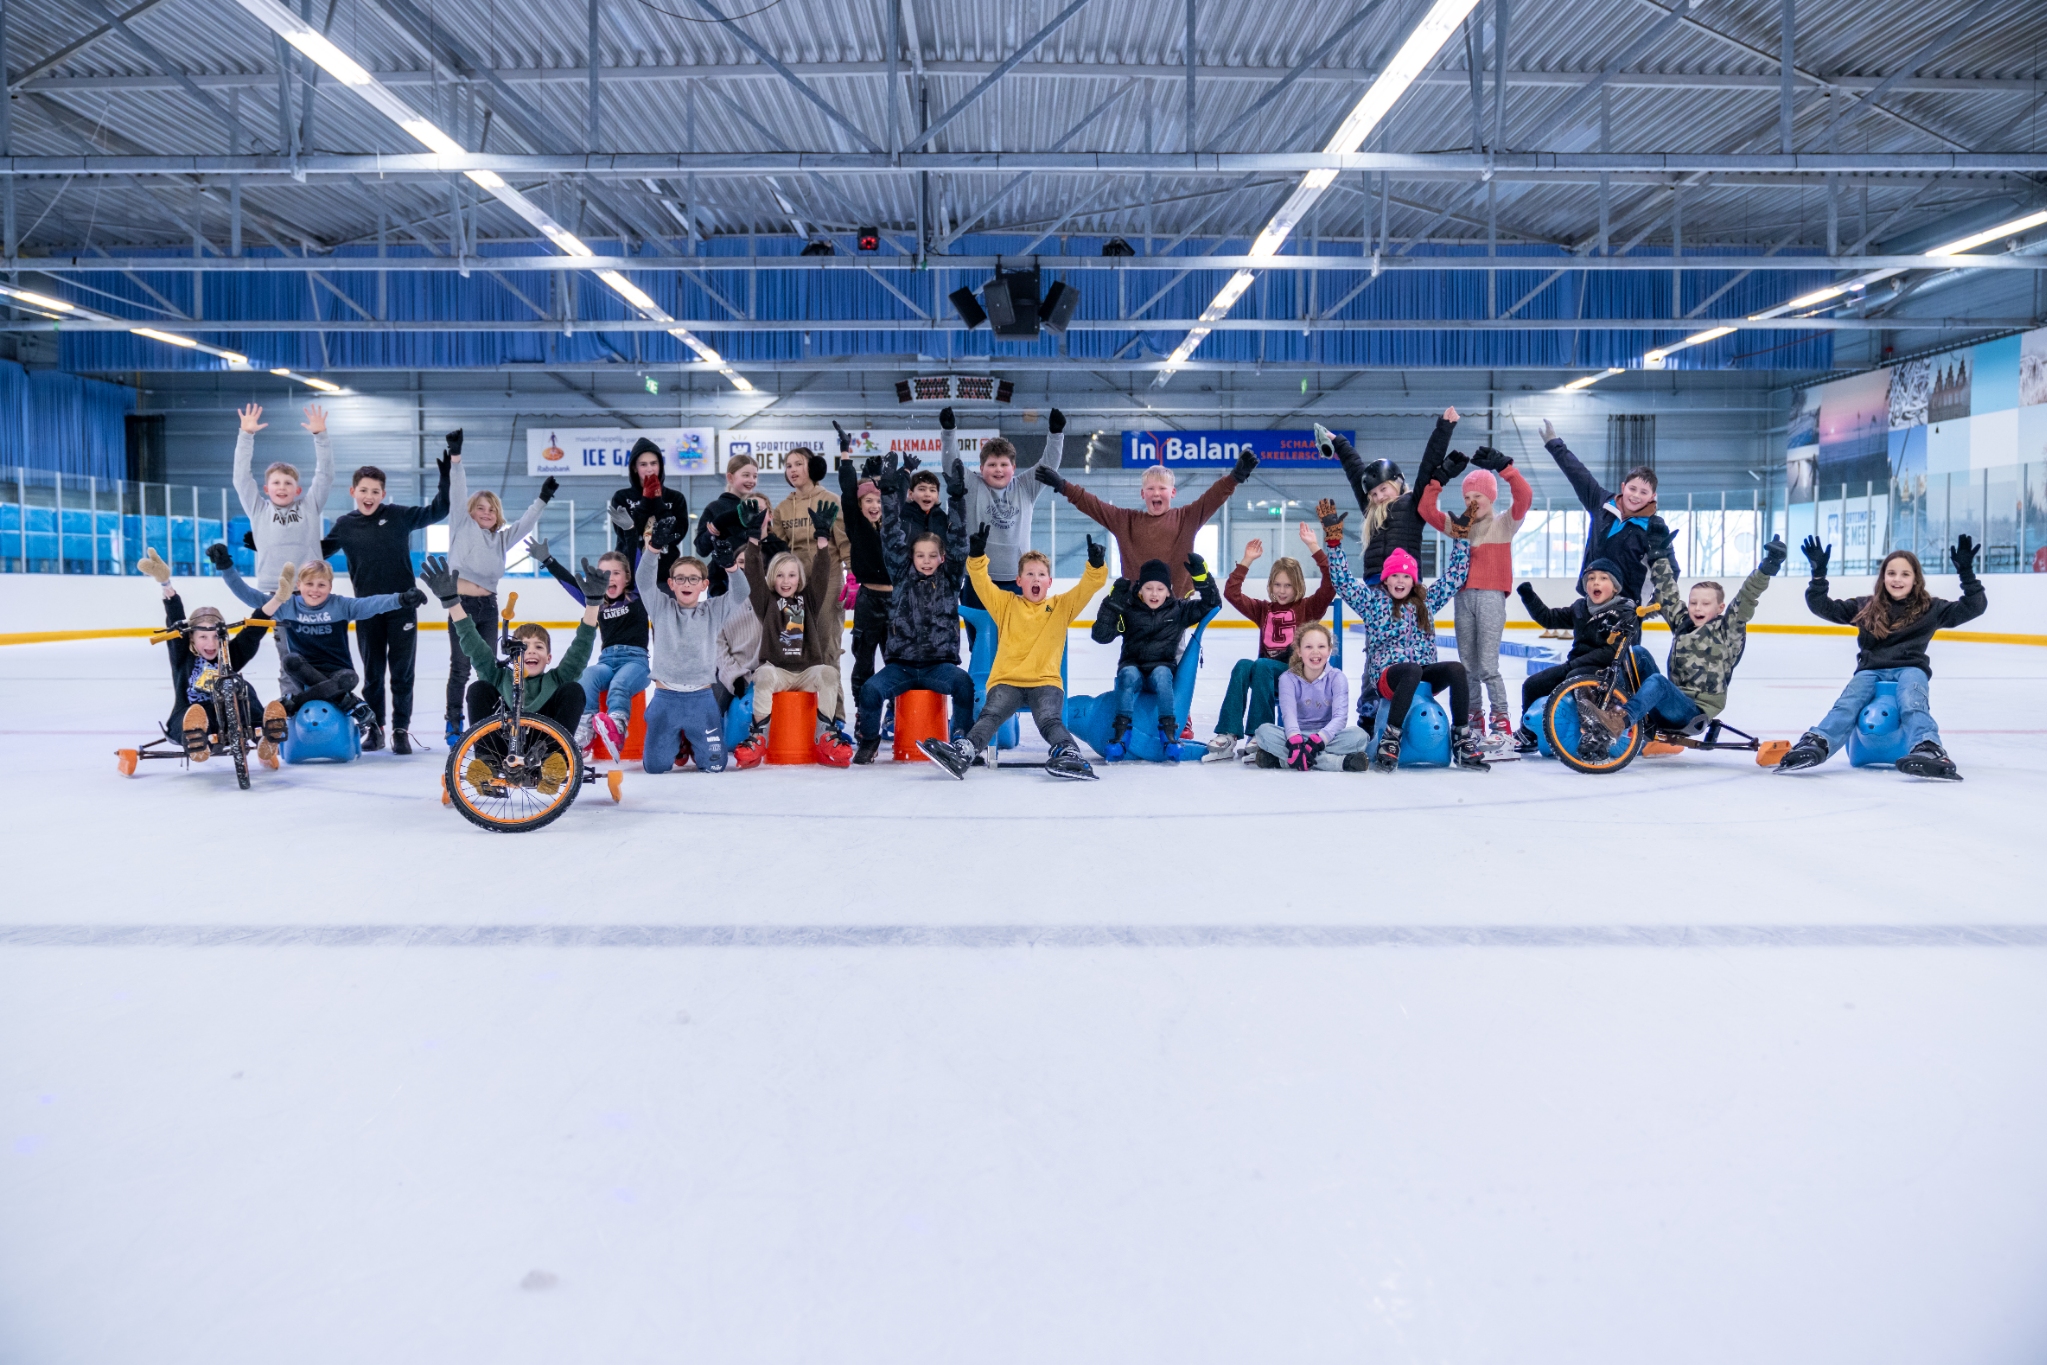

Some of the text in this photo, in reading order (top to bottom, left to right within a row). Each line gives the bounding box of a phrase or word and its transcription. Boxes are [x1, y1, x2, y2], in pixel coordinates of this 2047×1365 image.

[890, 438, 942, 452] ALKMAAR
[1281, 440, 1317, 449] SCHAA
[583, 449, 606, 466] ICE
[537, 465, 571, 473] Rabobank
[1851, 524, 1876, 546] MEET
[603, 605, 630, 620] LAKERS
[295, 624, 333, 636] JONES
[1263, 609, 1297, 651] G
